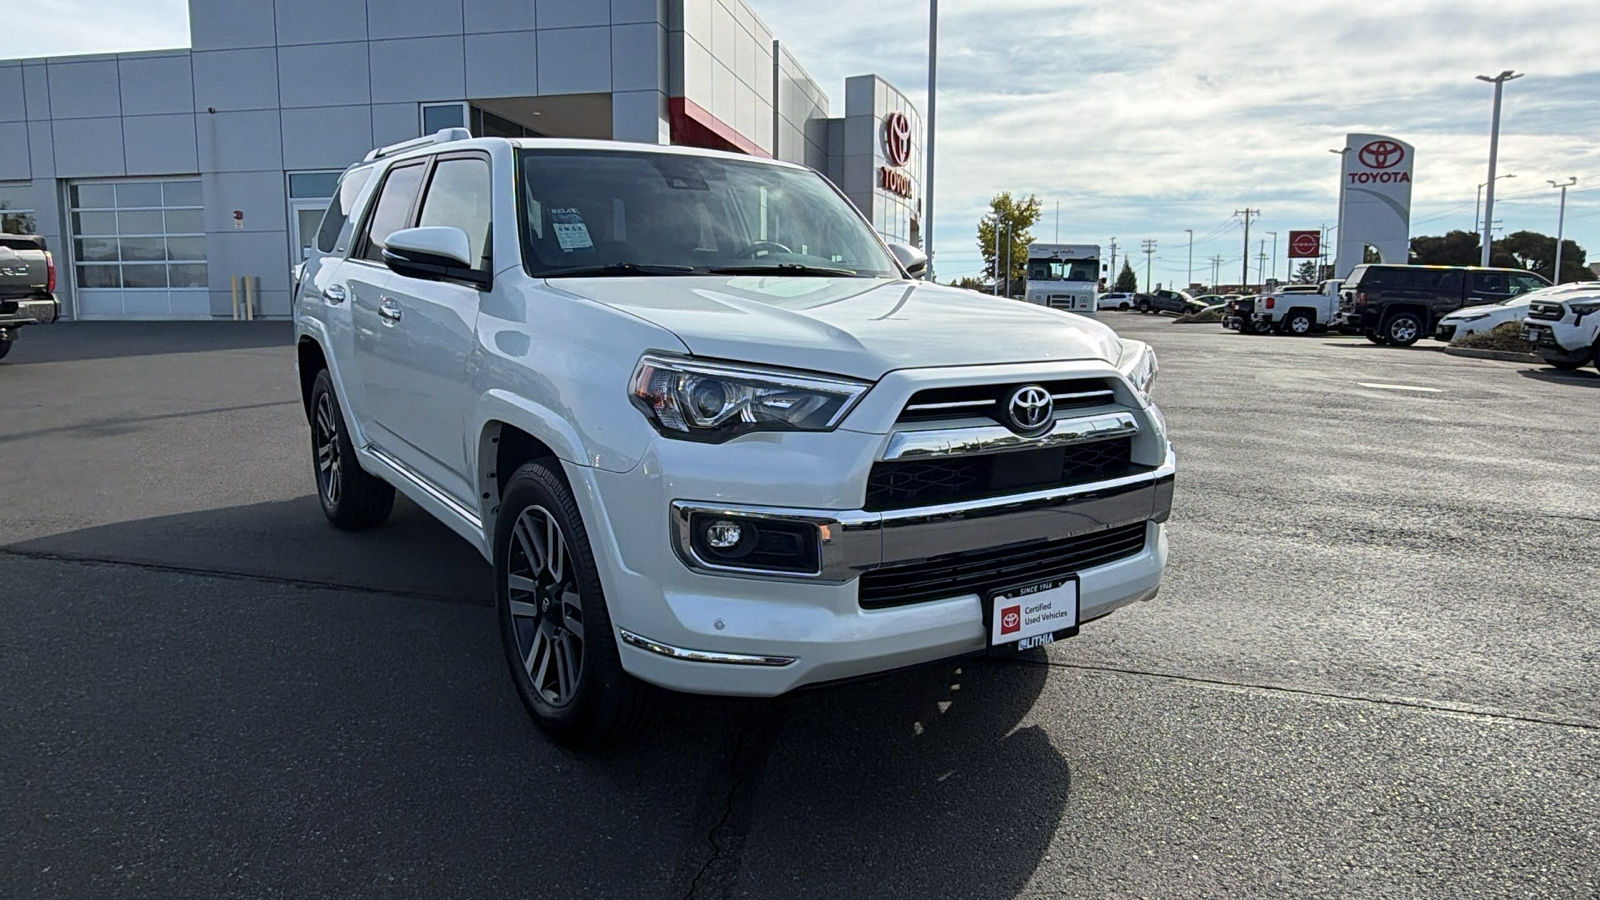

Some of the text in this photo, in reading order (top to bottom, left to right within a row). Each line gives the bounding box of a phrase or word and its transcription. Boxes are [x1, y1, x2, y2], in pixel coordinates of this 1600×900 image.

[880, 167, 912, 199] TOYOTA
[1348, 171, 1411, 184] TOYOTA
[1020, 582, 1053, 595] SINCE 1946
[1024, 602, 1052, 615] Certified
[1024, 610, 1068, 626] Used Vehicles
[1027, 632, 1054, 648] LITHIA
